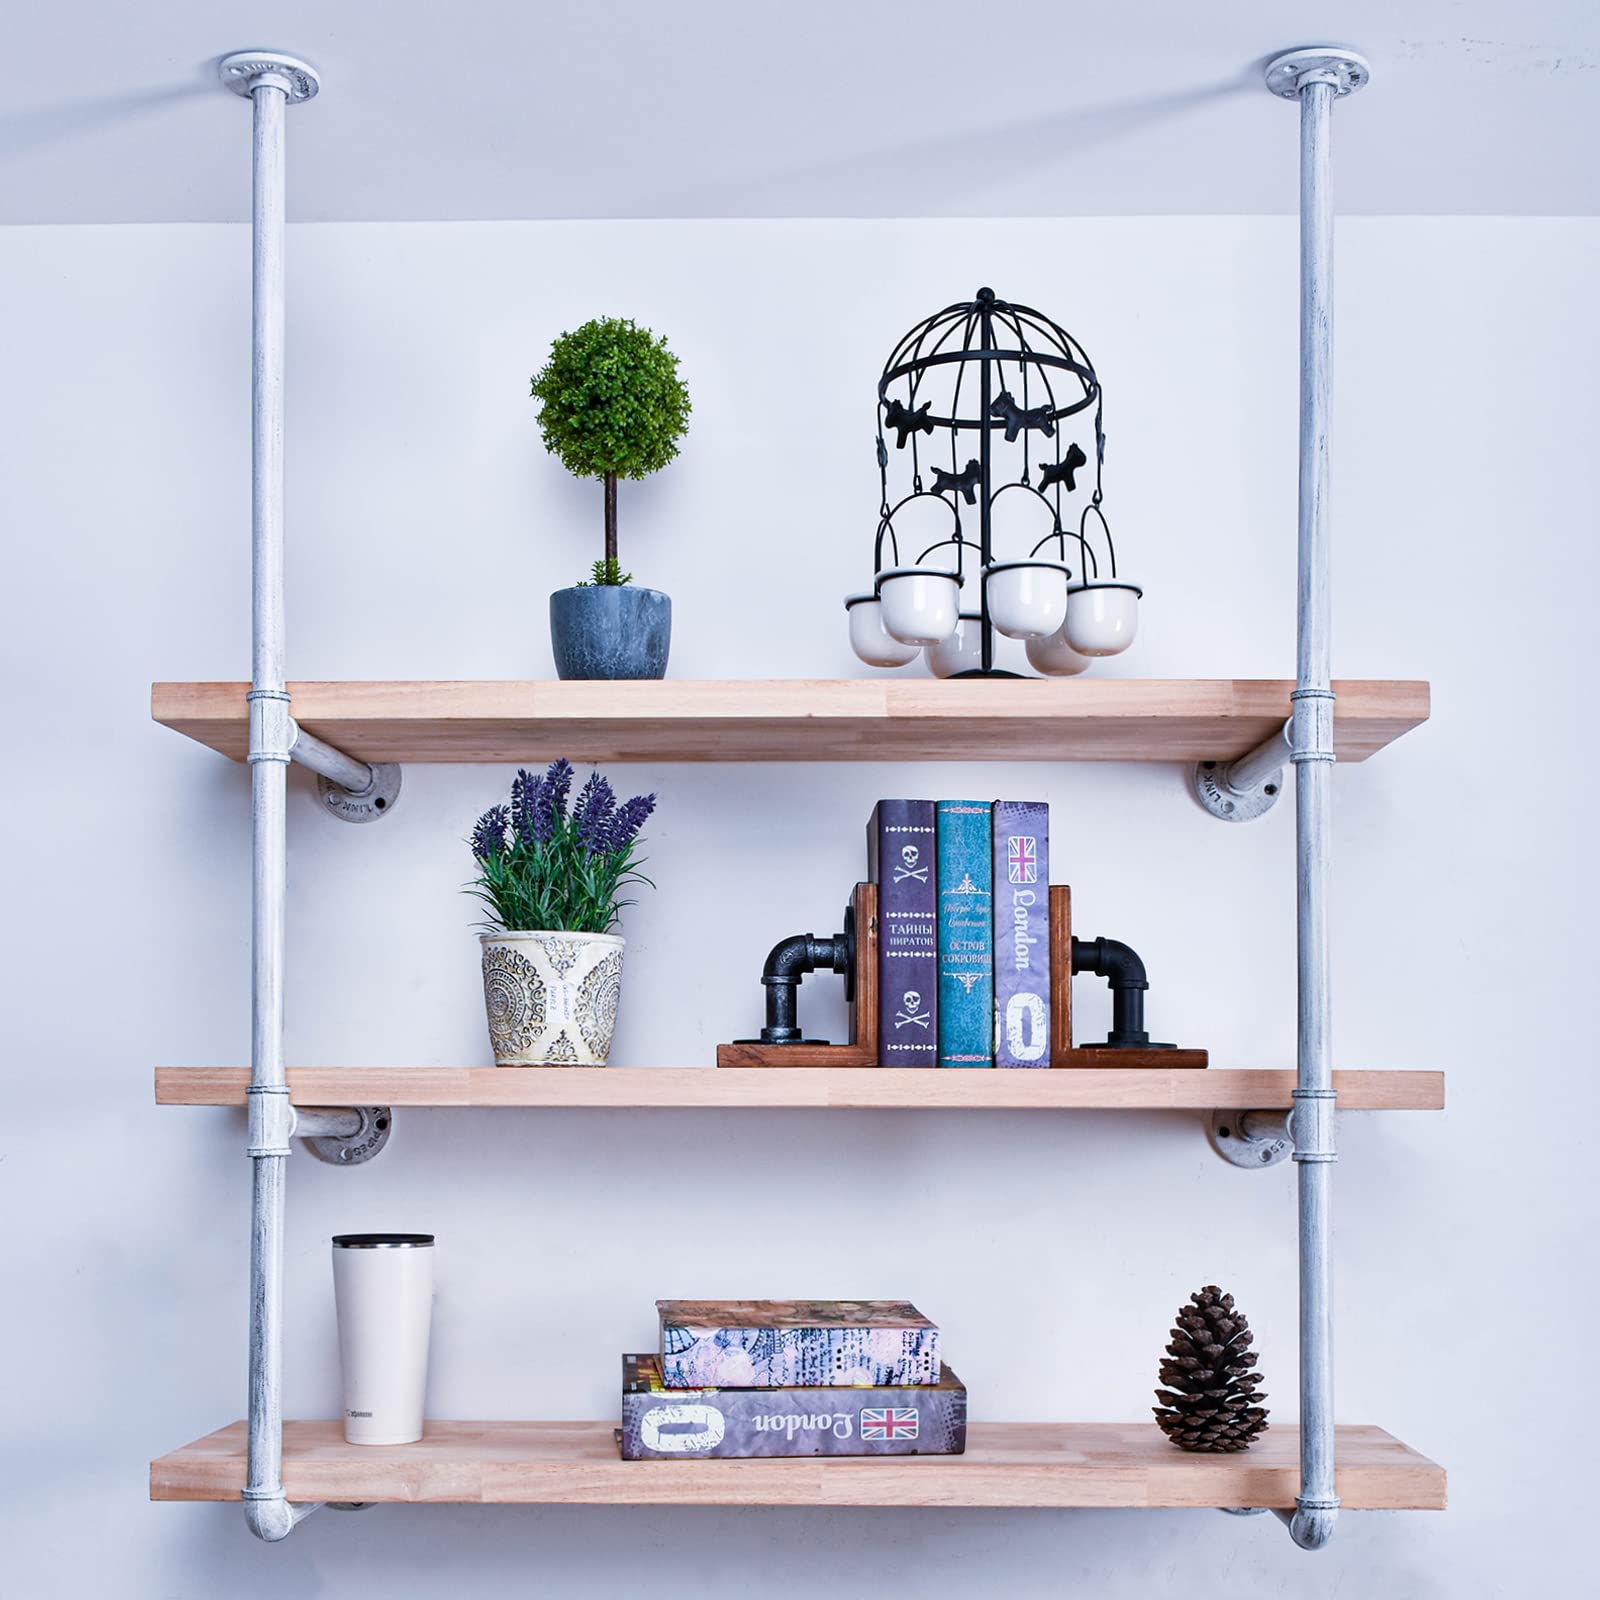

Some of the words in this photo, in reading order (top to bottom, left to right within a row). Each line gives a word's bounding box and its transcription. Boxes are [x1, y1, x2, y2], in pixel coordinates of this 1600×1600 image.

[1203, 774, 1222, 803] LINK
[888, 923, 932, 935] ТАЙНЫ
[889, 937, 934, 945] ПИРАТОВ
[1013, 889, 1037, 972] London
[949, 941, 985, 951] ОСТРОВ
[353, 1130, 382, 1157] PIPES
[752, 1412, 854, 1440] London
